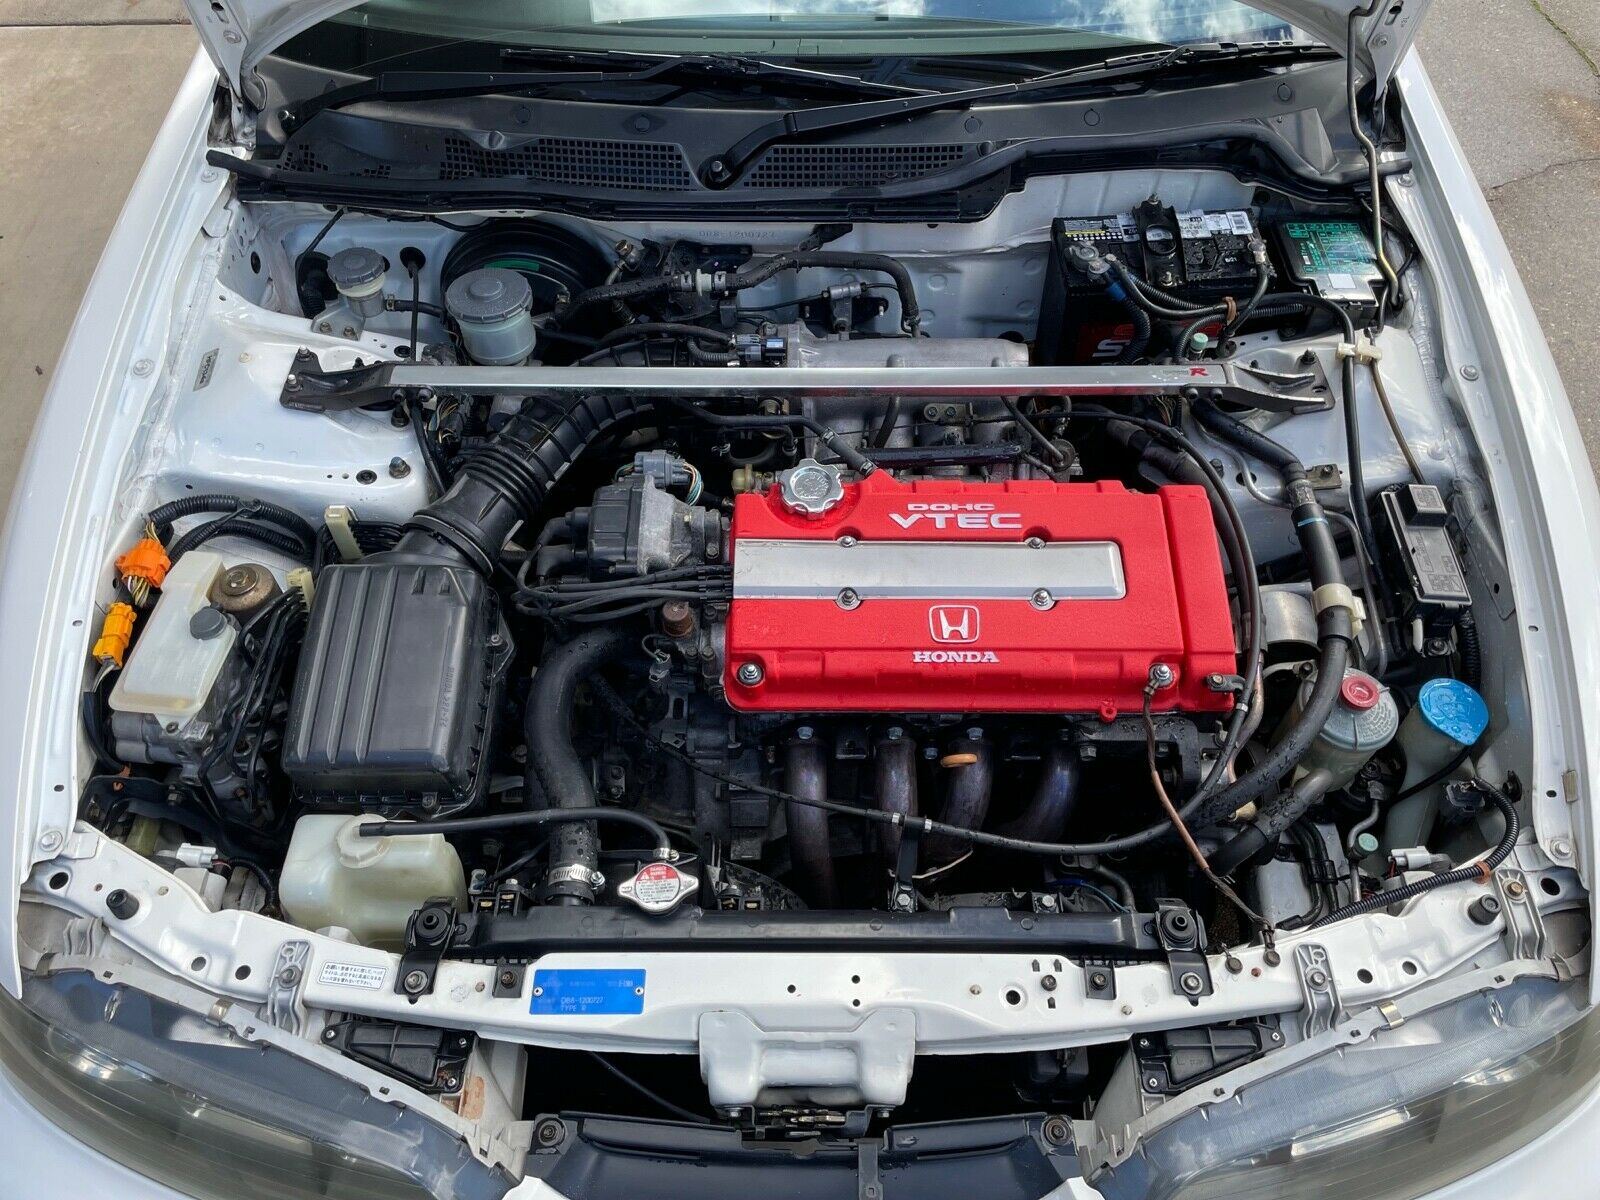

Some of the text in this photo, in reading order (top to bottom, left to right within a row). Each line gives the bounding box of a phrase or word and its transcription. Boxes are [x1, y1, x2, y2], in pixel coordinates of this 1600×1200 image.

[907, 503, 995, 511] DOHC
[889, 513, 1023, 529] VTEC
[912, 651, 1000, 663] HONDA
